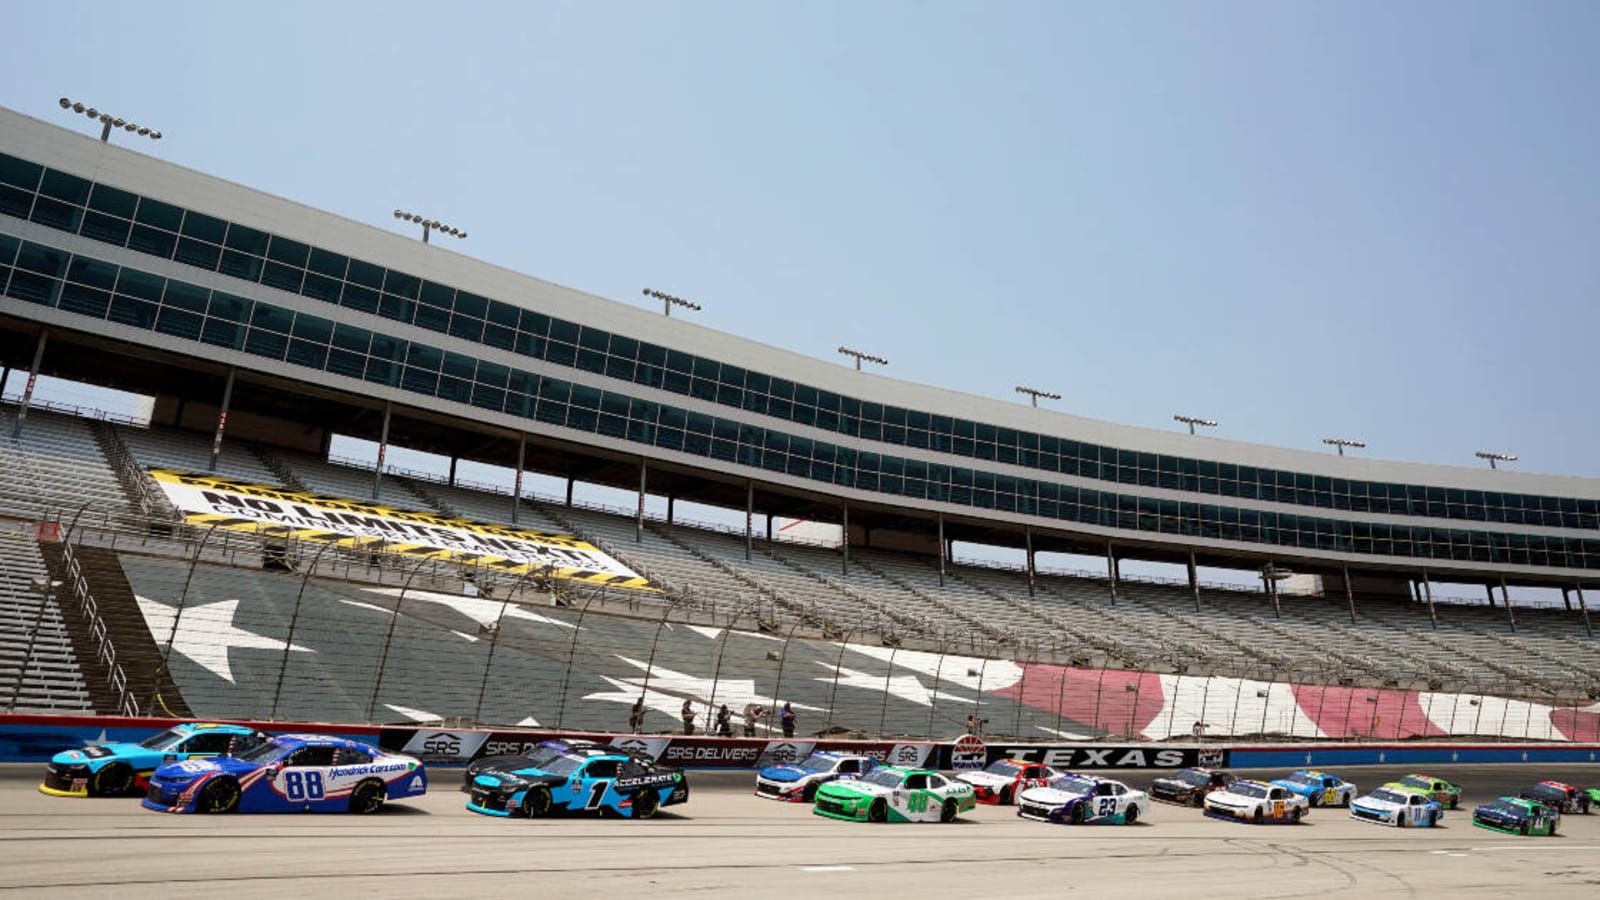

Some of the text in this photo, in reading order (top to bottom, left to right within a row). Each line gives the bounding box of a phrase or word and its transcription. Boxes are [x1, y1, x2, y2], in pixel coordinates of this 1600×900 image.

[209, 503, 355, 532] COMING
[200, 490, 598, 563] NO LIMITS NEXT!
[423, 741, 460, 756] SRS
[485, 742, 520, 755] SRS
[667, 747, 758, 760] SRS DELIVERS
[775, 750, 796, 761] SRS
[898, 751, 918, 762] SRS
[1005, 750, 1184, 766] TEXAS
[285, 770, 325, 800] 88
[584, 780, 609, 810] 1
[1099, 798, 1117, 816] 23
